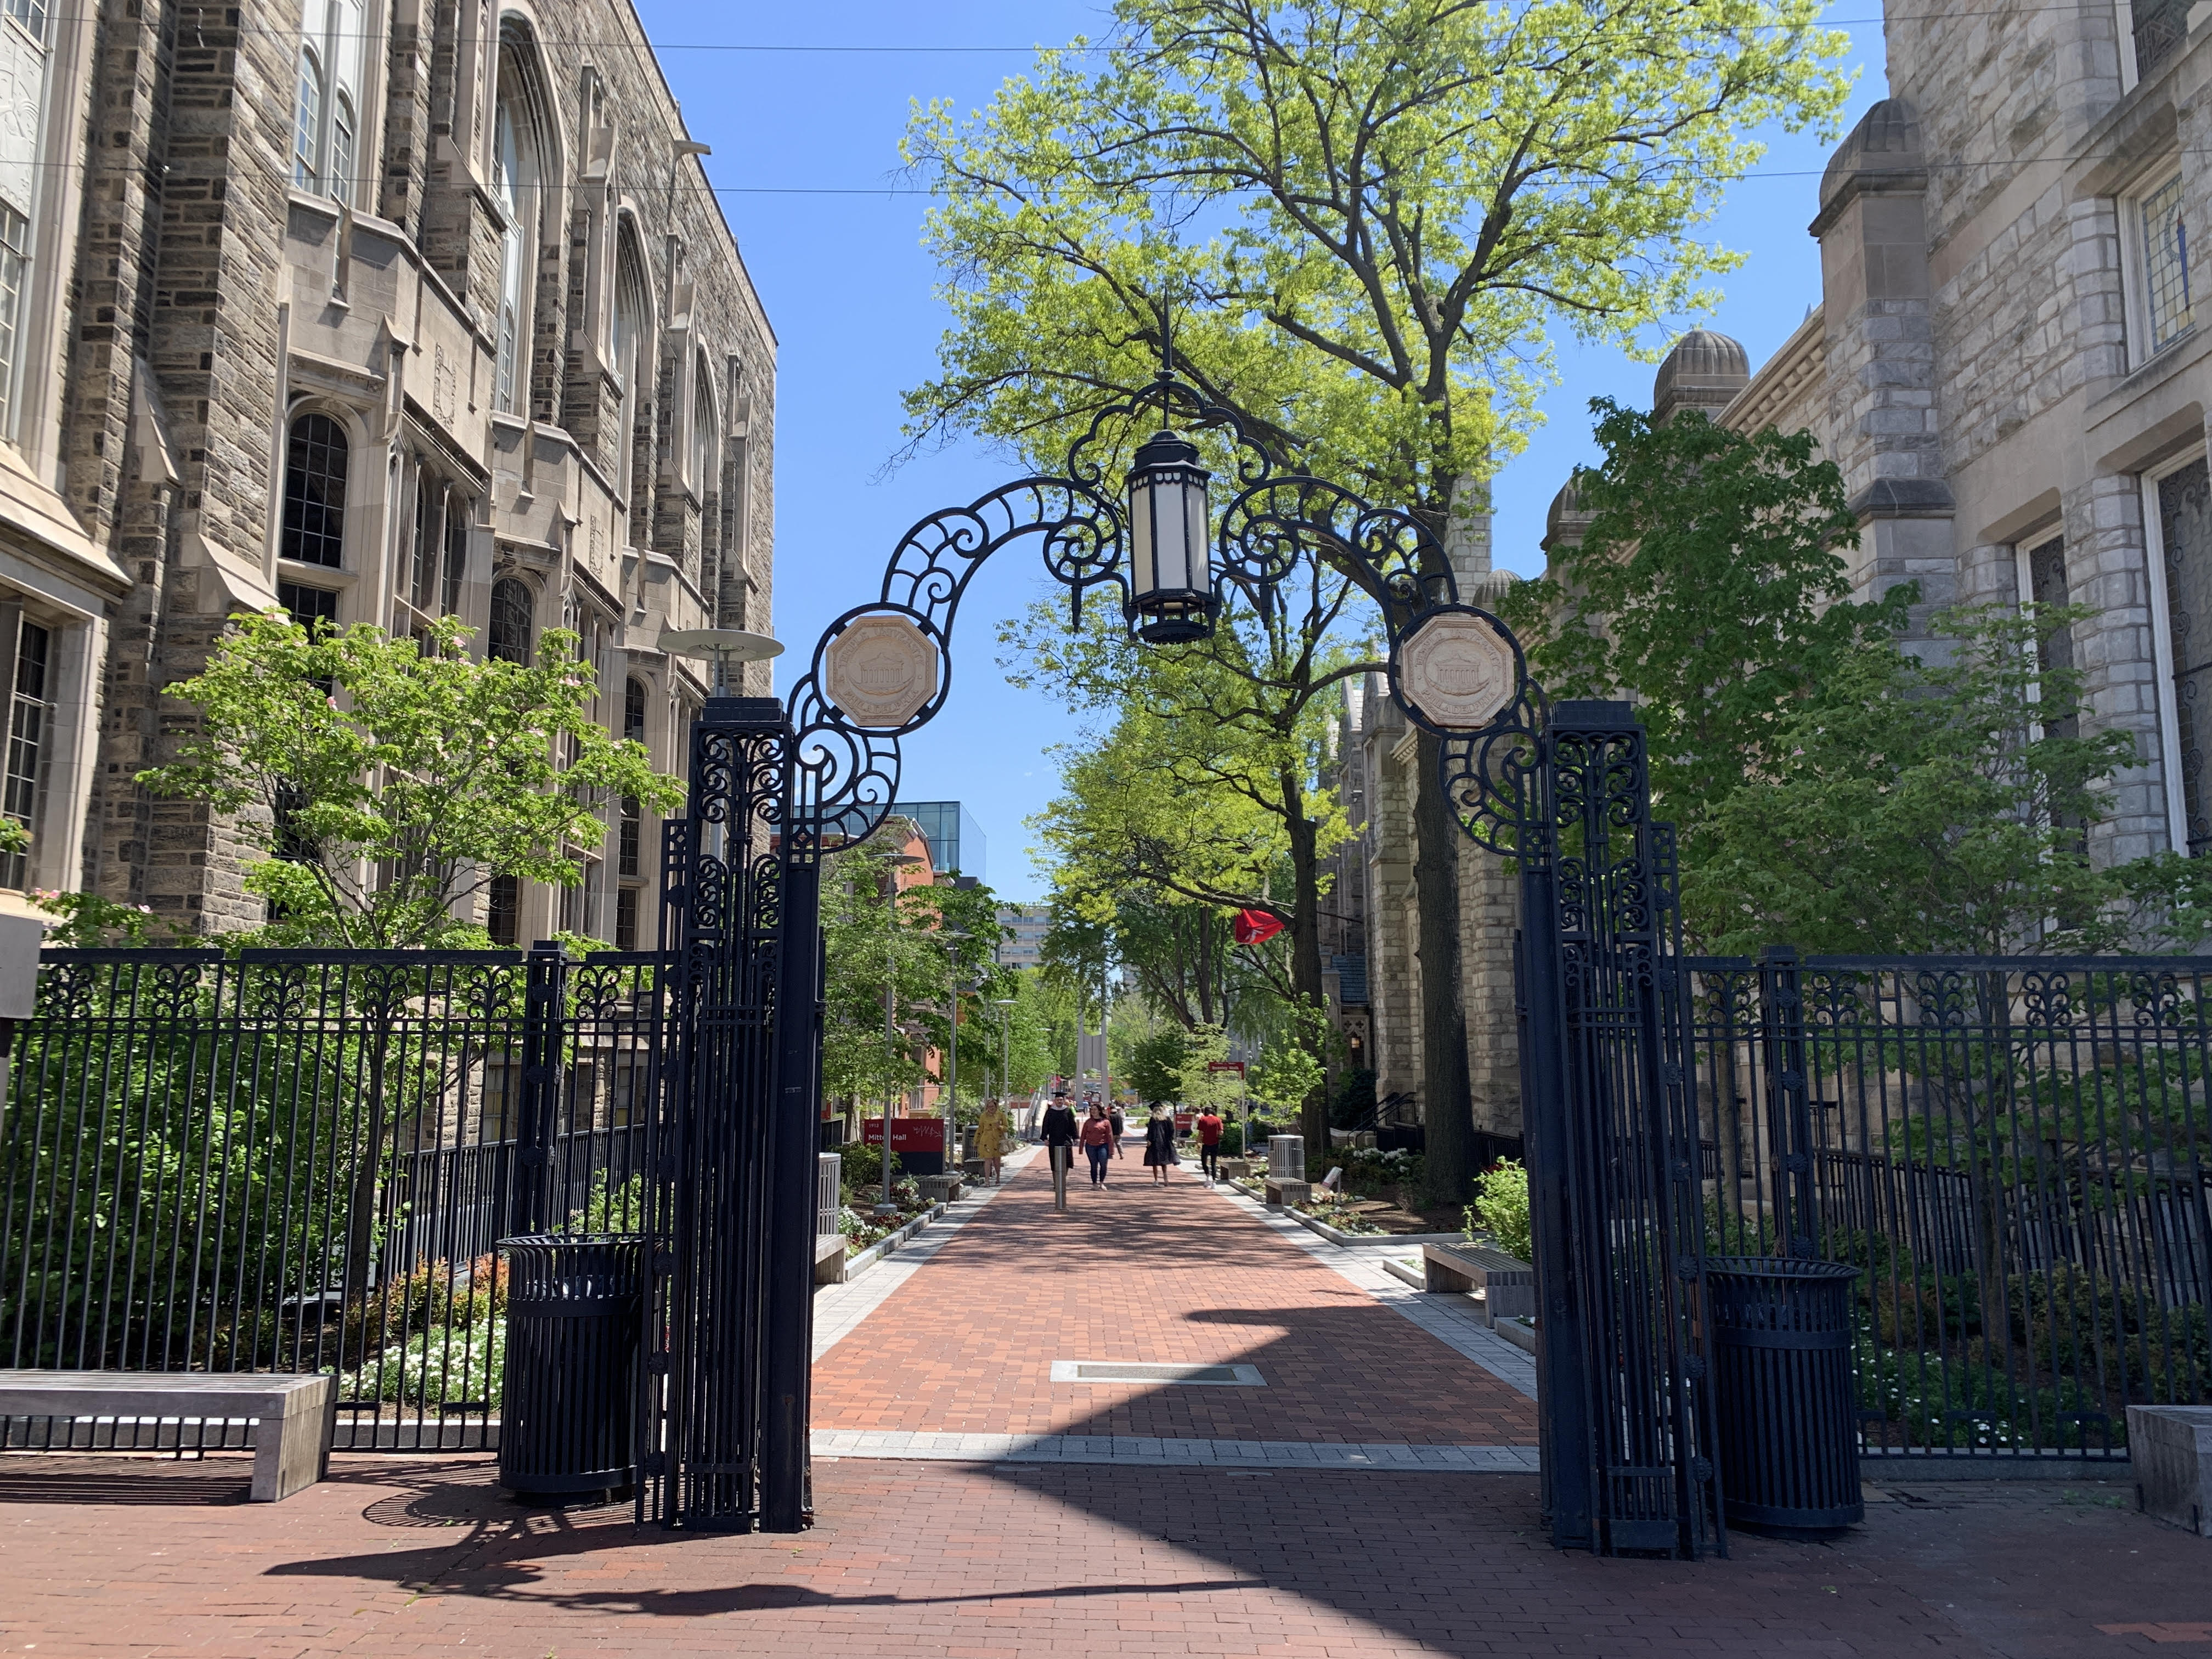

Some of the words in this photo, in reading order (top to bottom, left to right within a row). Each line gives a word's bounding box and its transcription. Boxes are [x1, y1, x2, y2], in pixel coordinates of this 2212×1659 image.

[838, 630, 870, 669] TEMPLE
[873, 627, 924, 666] UNIVERSITY
[1415, 632, 1446, 668] TEMPLE
[1449, 629, 1502, 669] UNIVERSITY
[844, 689, 919, 714] PHILADELPHIA
[1421, 689, 1497, 715] PHILADELPHIA
